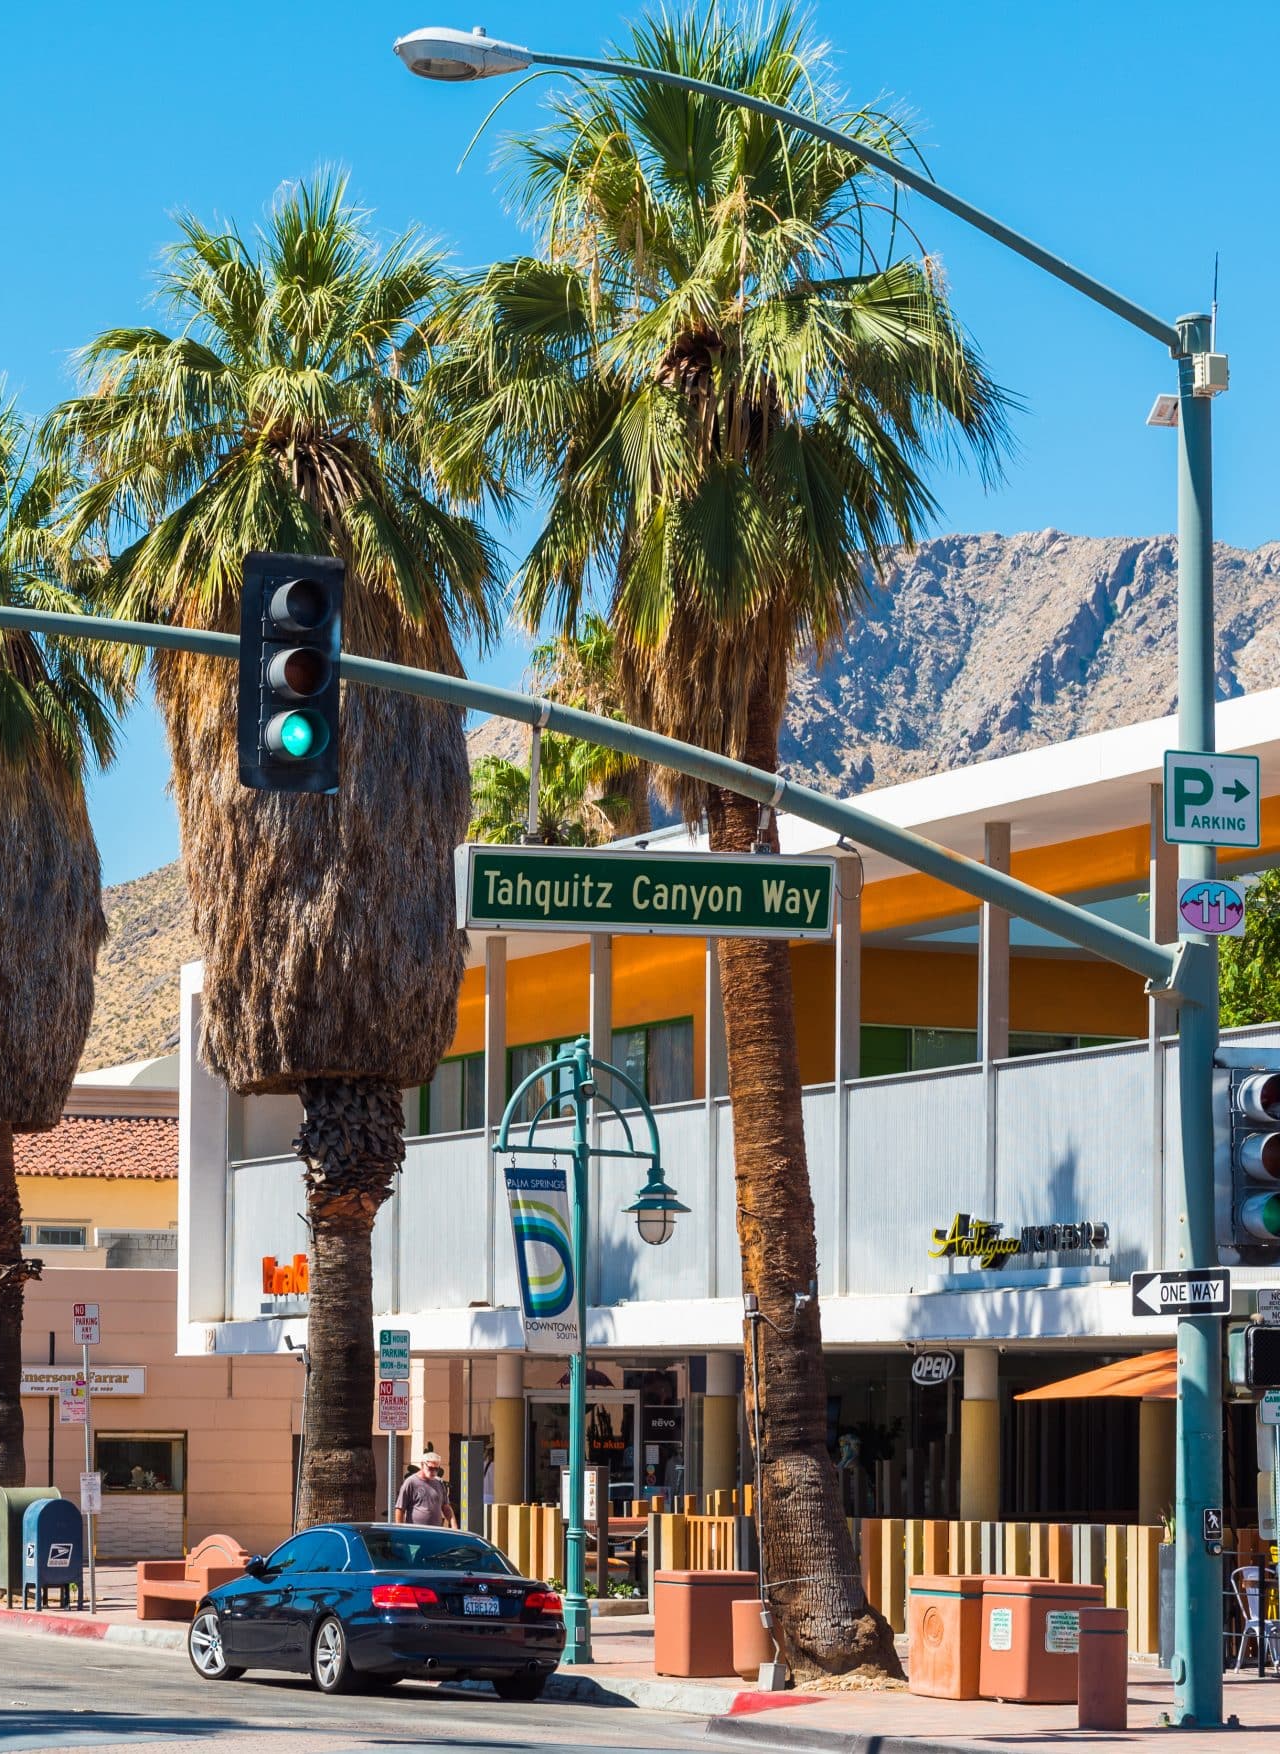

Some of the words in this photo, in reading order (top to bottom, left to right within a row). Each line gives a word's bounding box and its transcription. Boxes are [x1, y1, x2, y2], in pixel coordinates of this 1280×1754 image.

[484, 870, 613, 916] Tahquitz
[632, 875, 742, 920] Canyon
[762, 879, 821, 924] Way
[1198, 889, 1227, 924] 11
[506, 1178, 528, 1189] PALM
[530, 1179, 567, 1190] SPRINGS
[1161, 1284, 1187, 1302] ONE
[1192, 1282, 1220, 1301] WAY
[74, 1305, 85, 1315] NO
[75, 1317, 98, 1326] PARKING
[525, 1321, 577, 1332] DOWNTOWN
[382, 1332, 389, 1343] 3
[392, 1335, 407, 1344] HOUR
[556, 1332, 578, 1340] SOUTH
[382, 1348, 408, 1358] PARKING
[914, 1356, 951, 1379] OPEN
[380, 1383, 392, 1394] NO
[380, 1397, 408, 1406] PARKING
